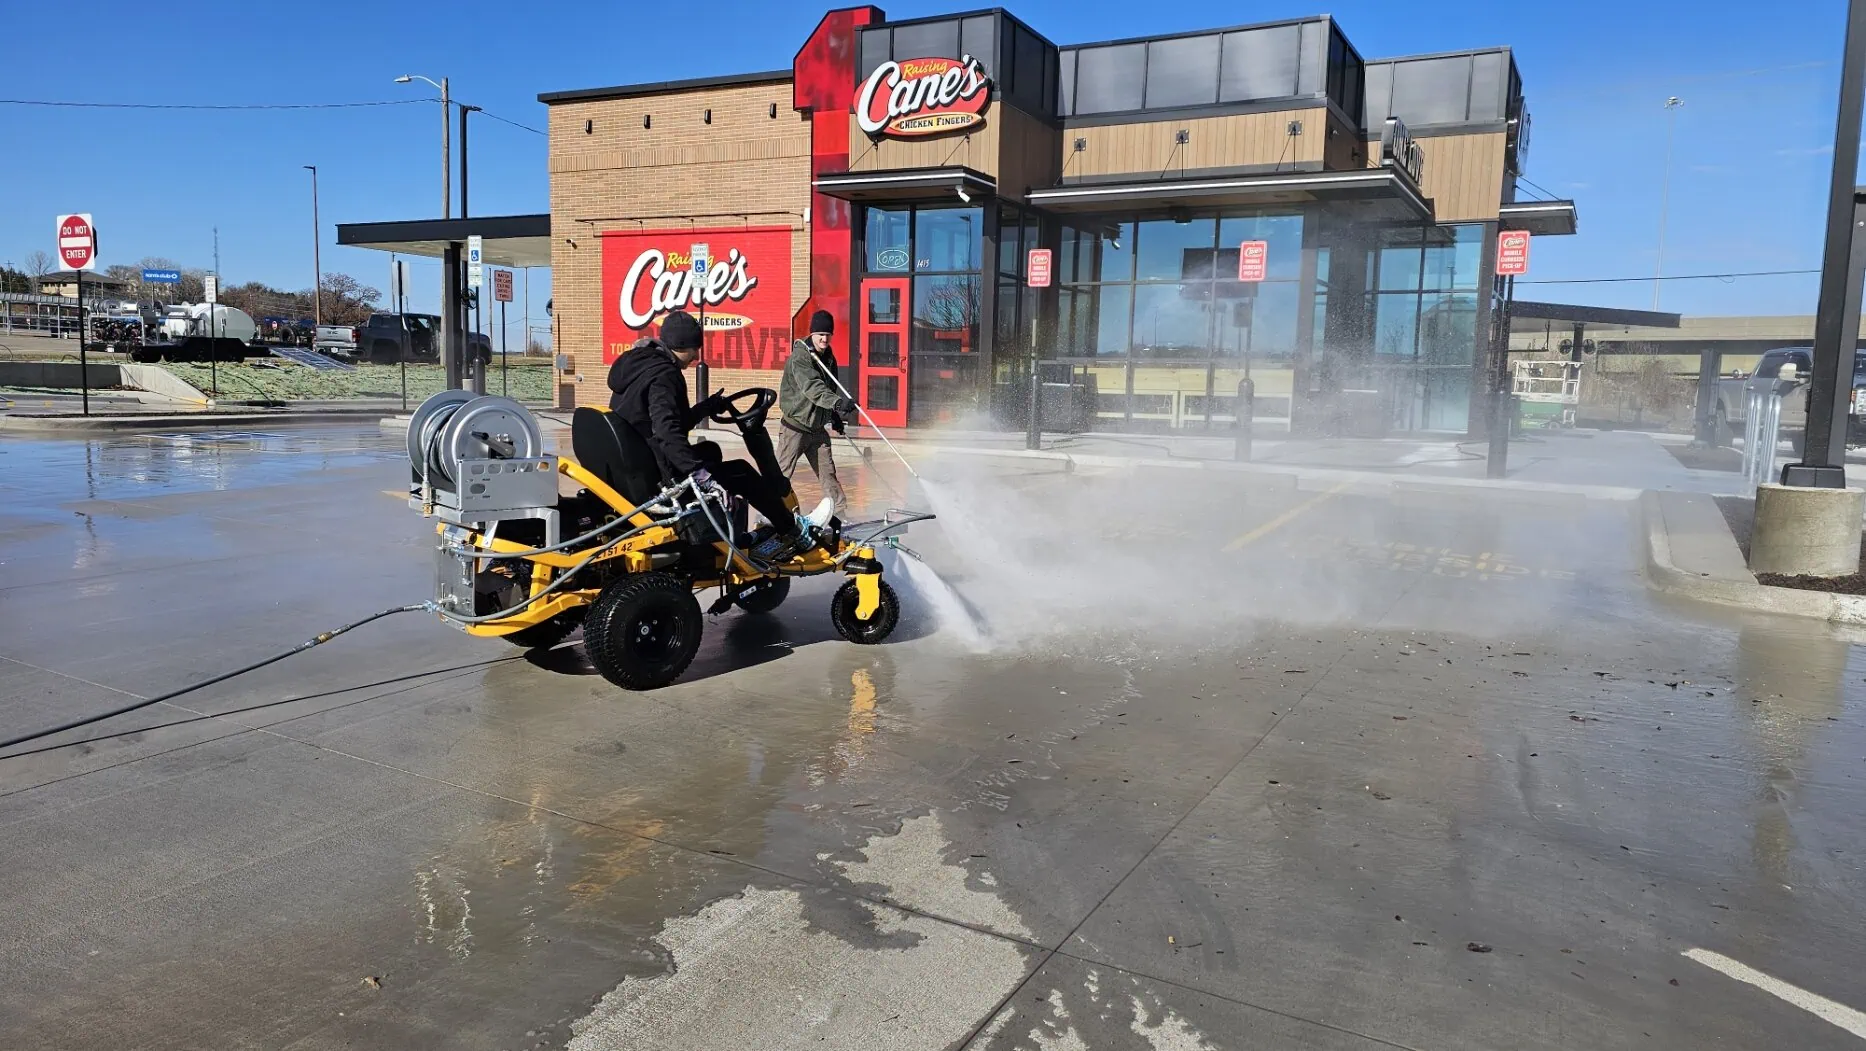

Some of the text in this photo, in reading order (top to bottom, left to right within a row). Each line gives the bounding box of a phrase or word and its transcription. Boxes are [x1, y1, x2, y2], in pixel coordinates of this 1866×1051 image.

[903, 60, 948, 79] Raising
[857, 54, 988, 133] Cane's
[899, 116, 971, 130] CHICKEN FINGERS
[62, 226, 87, 235] DO NOT
[66, 250, 87, 259] ENTER
[619, 248, 757, 327] Cane's
[704, 316, 742, 326] FINGERS
[704, 327, 790, 370] LOVE
